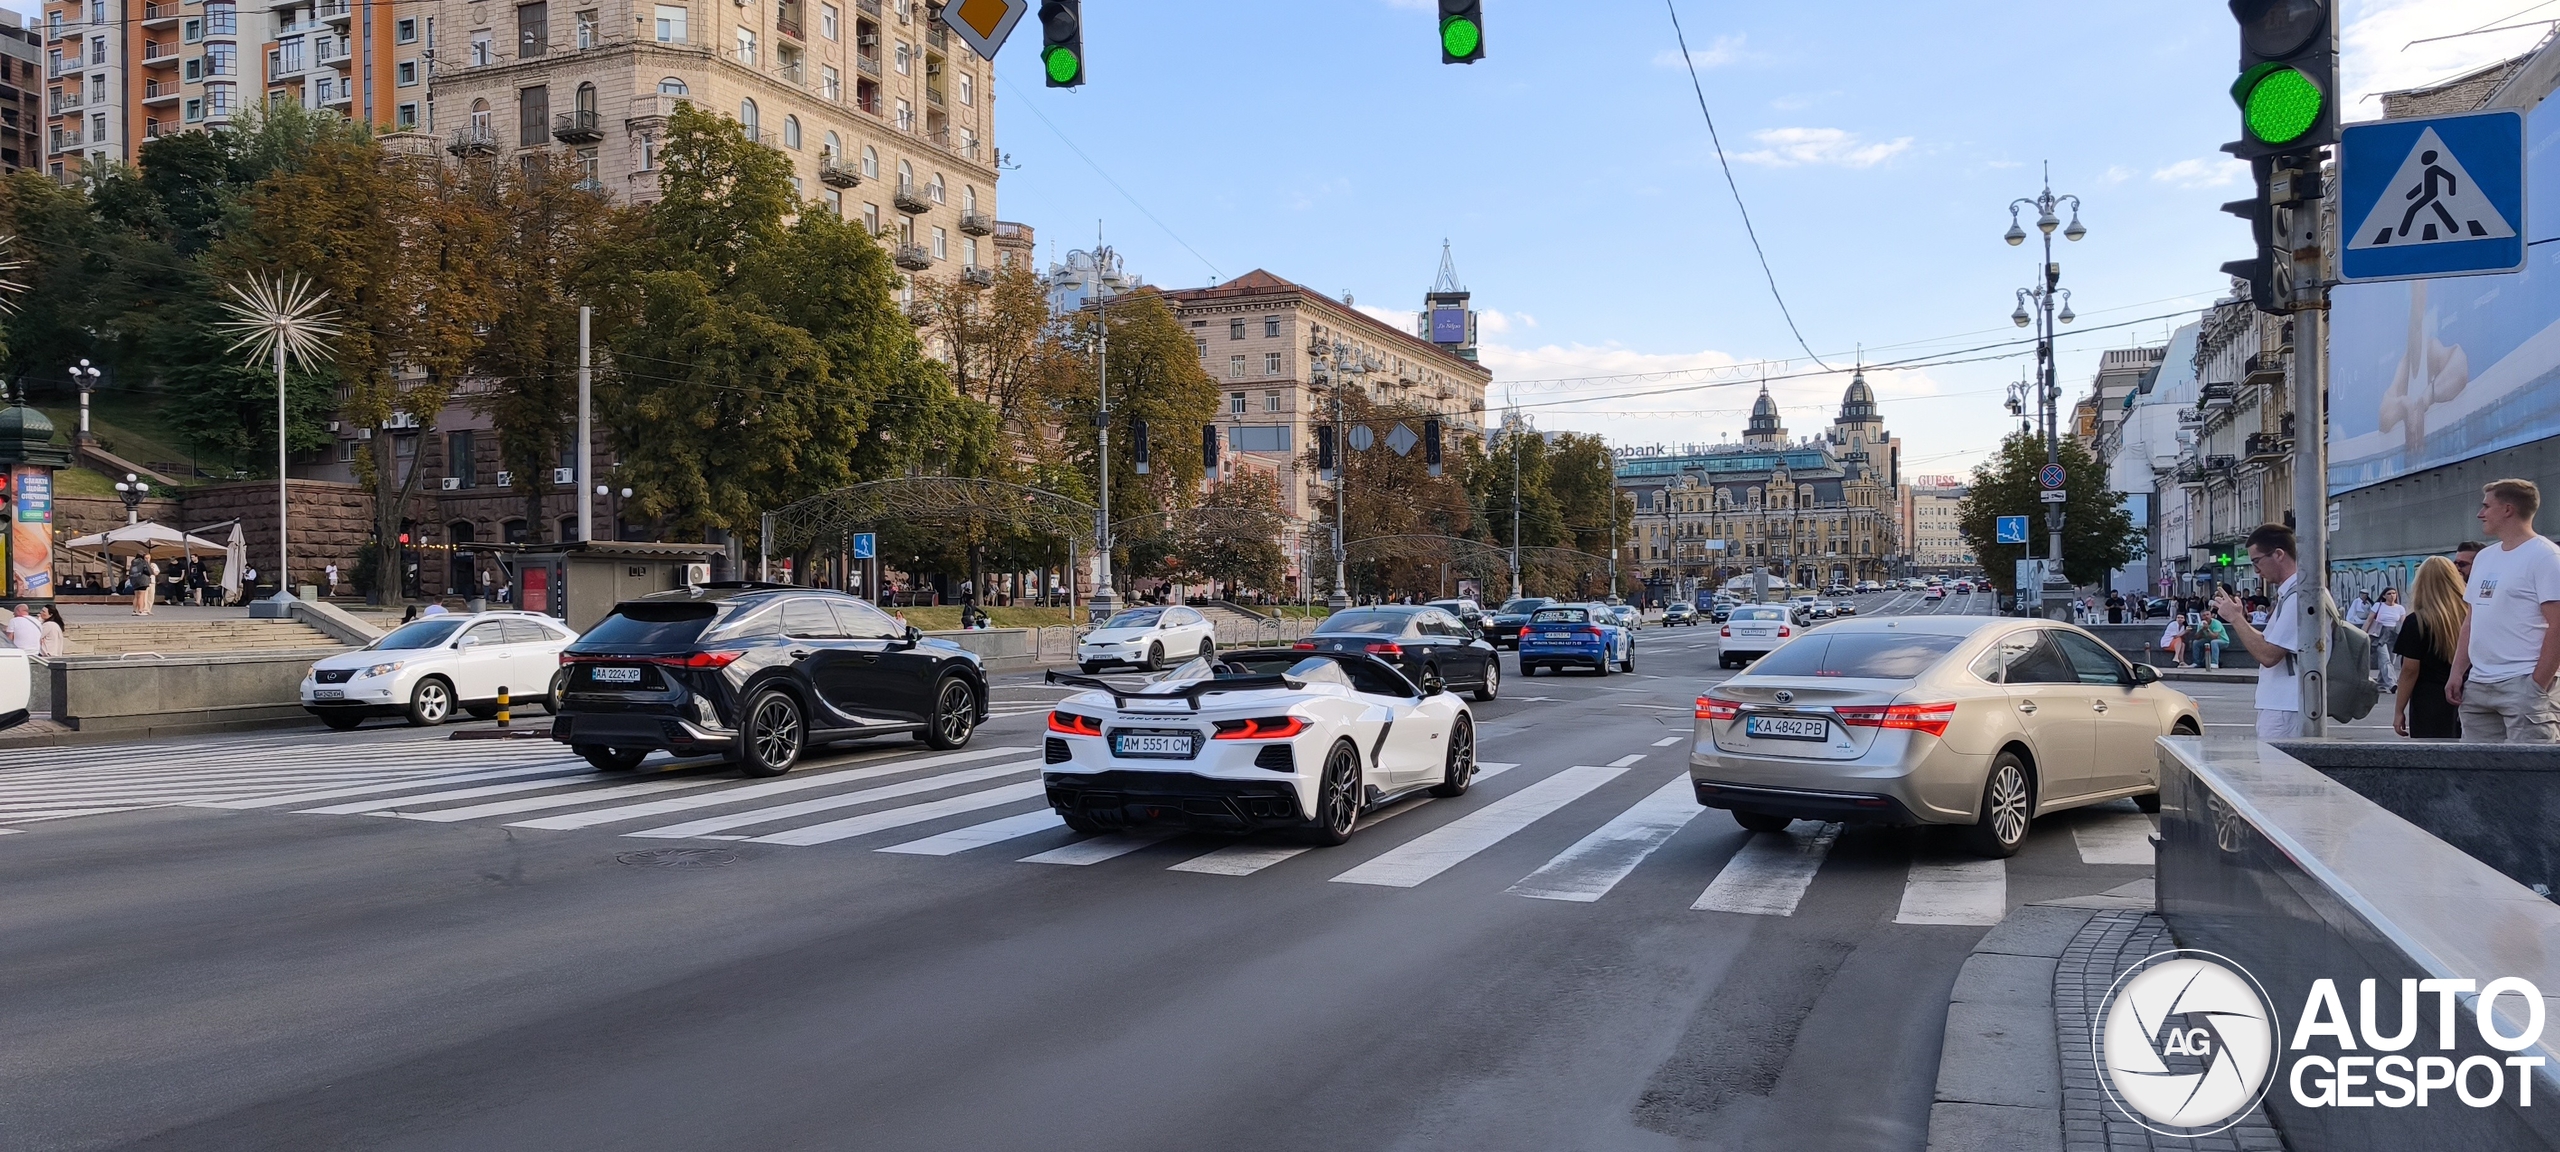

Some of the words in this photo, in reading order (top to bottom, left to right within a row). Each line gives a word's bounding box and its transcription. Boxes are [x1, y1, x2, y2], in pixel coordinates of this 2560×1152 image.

[1918, 474, 1955, 486] GUESS
[2016, 592, 2025, 611] ONE
[596, 669, 606, 678] AA
[608, 669, 625, 679] 2224
[628, 669, 639, 679] XP
[1754, 719, 1772, 733] KA
[1775, 720, 1802, 735] 4842
[1804, 722, 1822, 736] PB
[1123, 737, 1140, 750] AM
[1142, 738, 1169, 751] 5551
[1172, 738, 1190, 752] CM
